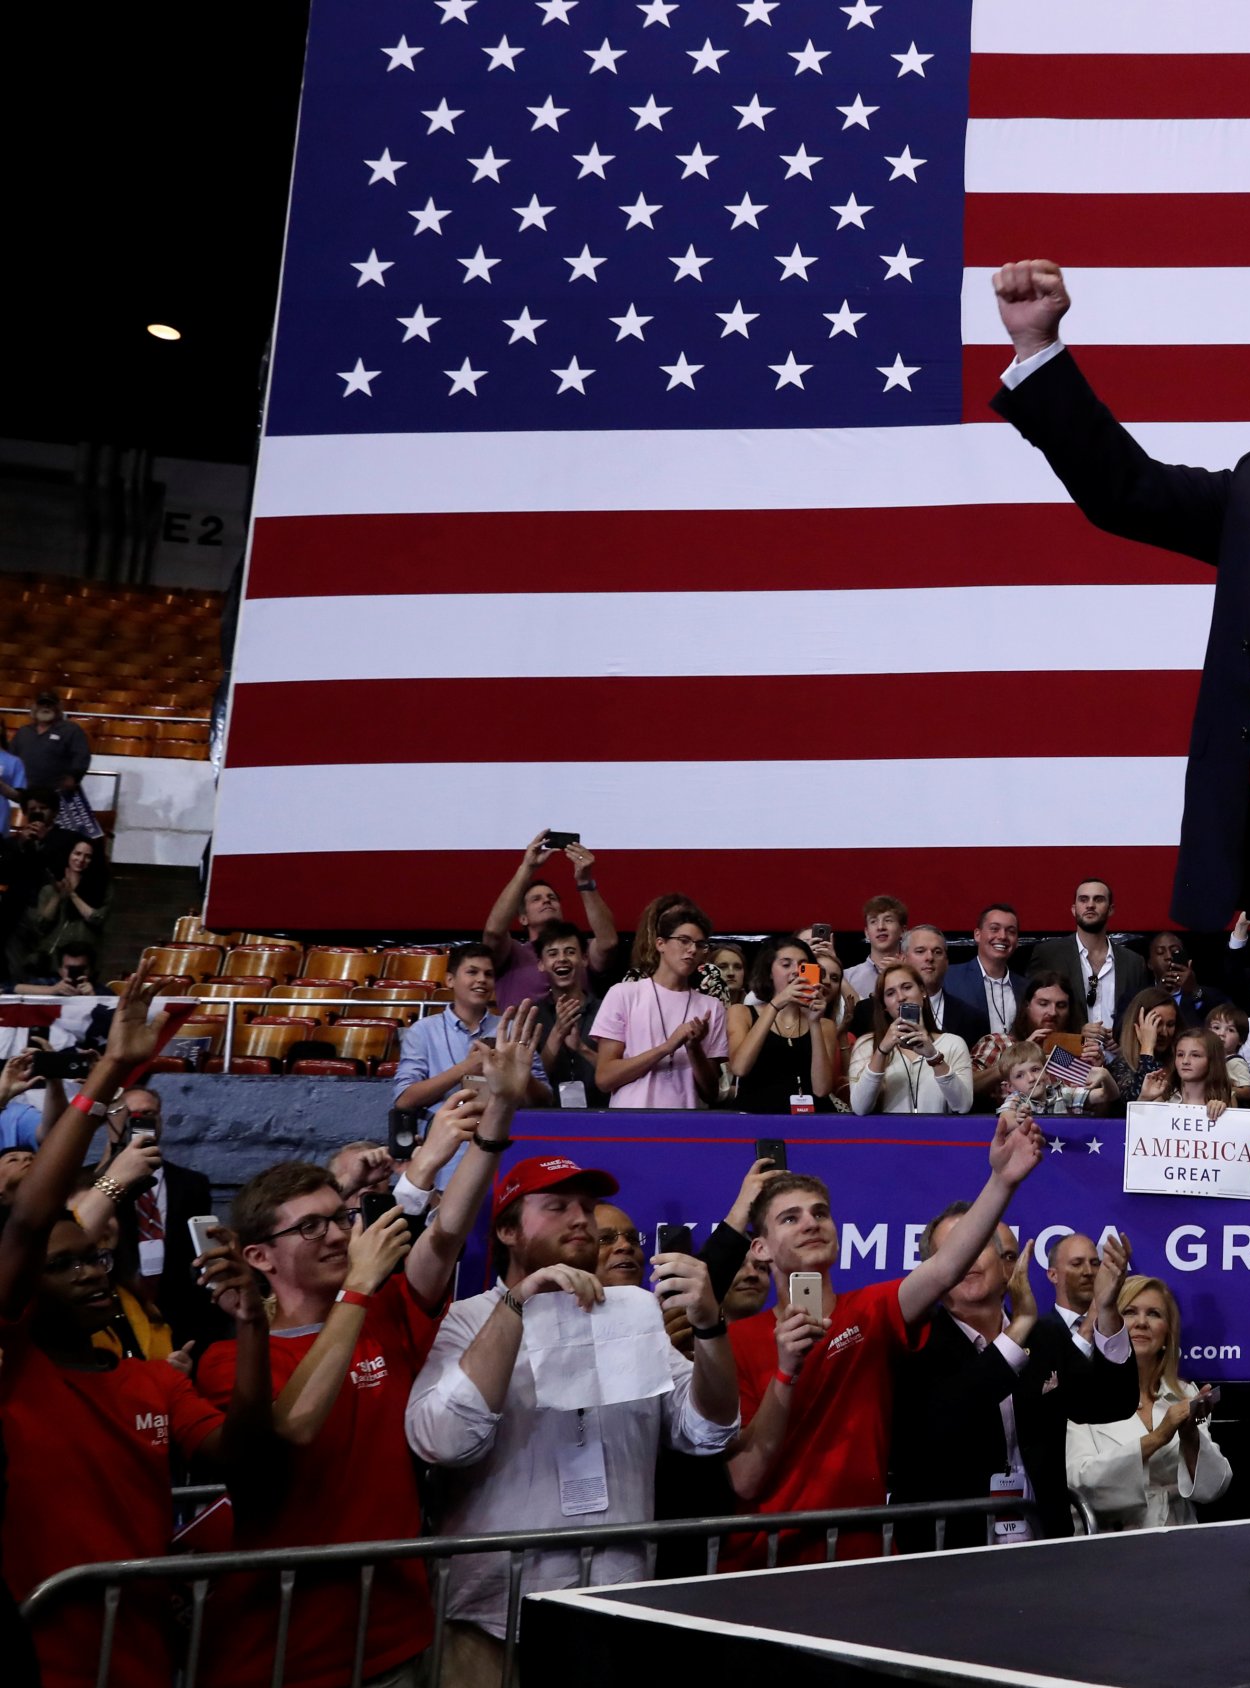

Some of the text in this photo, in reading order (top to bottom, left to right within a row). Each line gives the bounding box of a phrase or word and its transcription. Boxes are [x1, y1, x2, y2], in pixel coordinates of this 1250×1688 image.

[1171, 1117, 1216, 1132] KEEP
[1164, 1166, 1221, 1182] GREAT
[1179, 1345, 1241, 1360] .com
[1003, 1522, 1017, 1532] VIP
